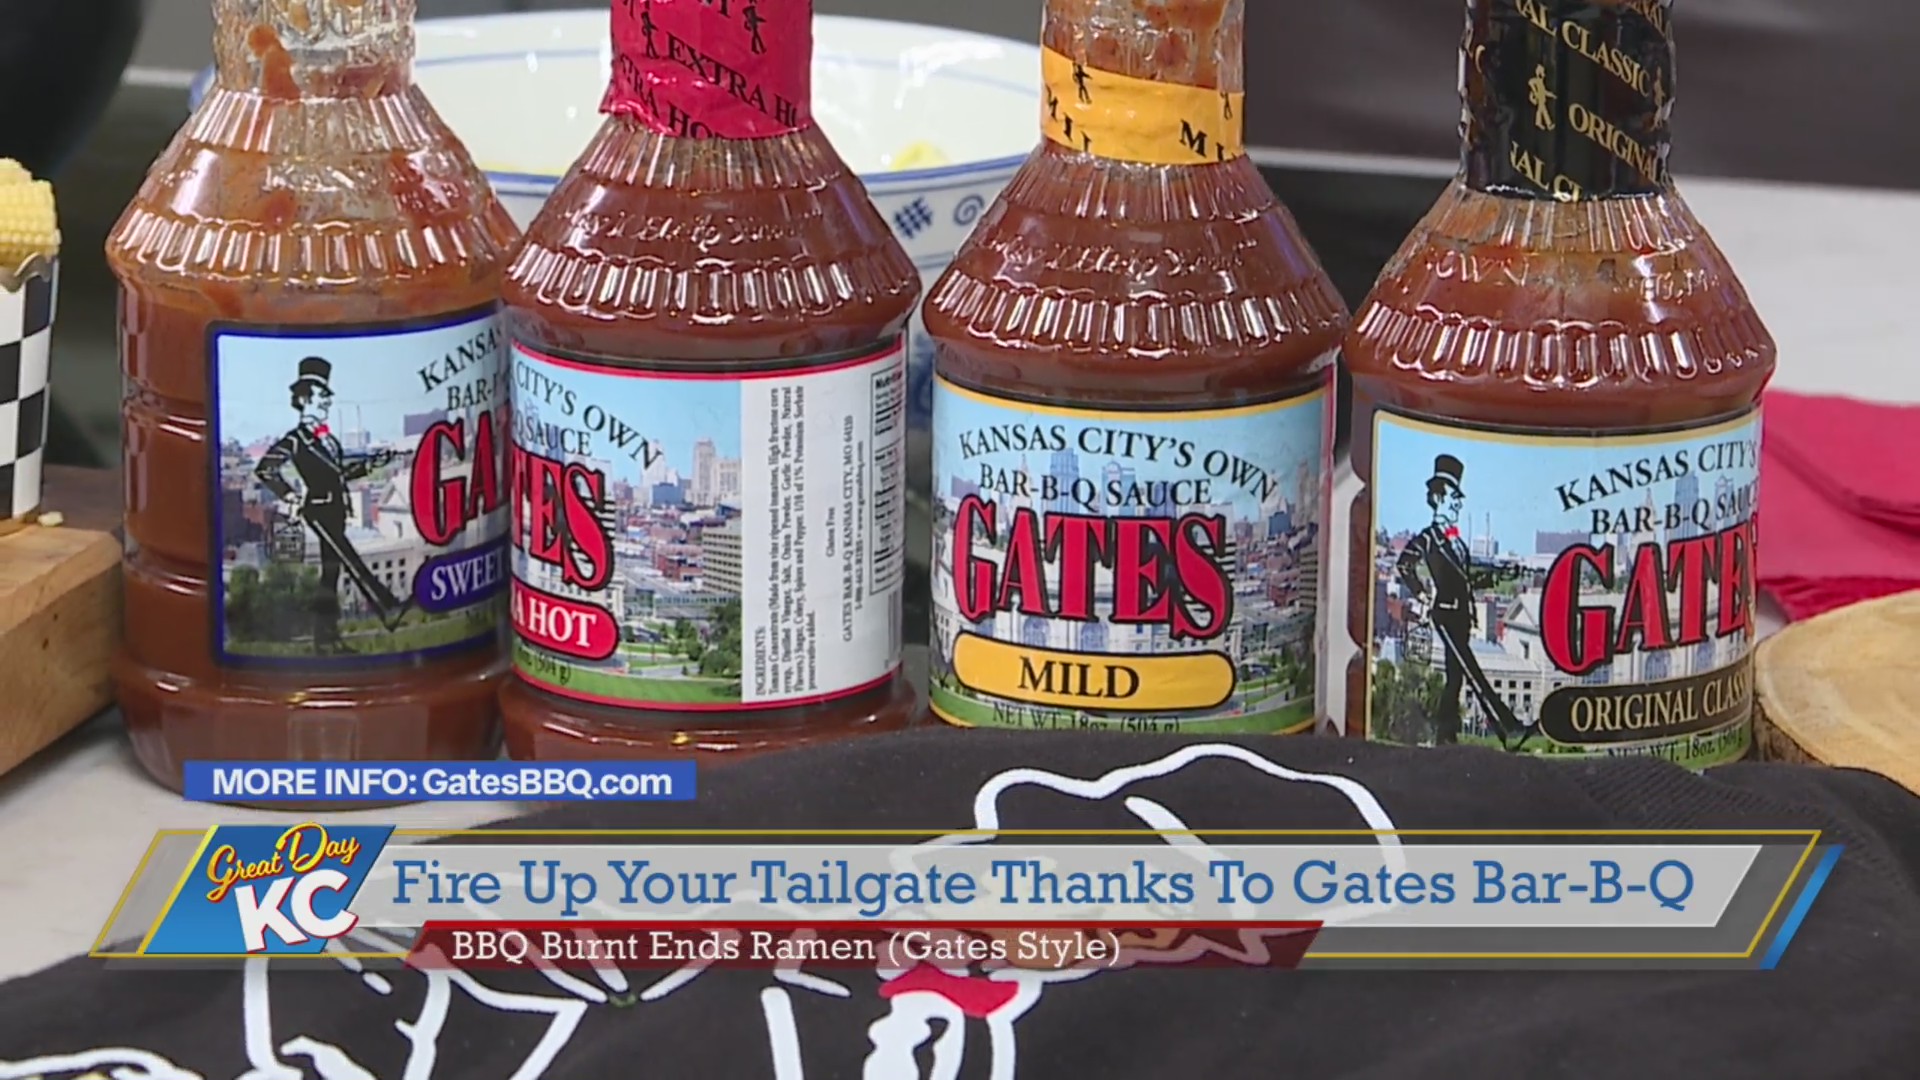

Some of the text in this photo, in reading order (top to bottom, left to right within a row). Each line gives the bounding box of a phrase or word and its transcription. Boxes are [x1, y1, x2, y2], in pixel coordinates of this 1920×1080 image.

[666, 31, 768, 114] EXTRA
[1562, 20, 1650, 97] CLASSIC
[516, 360, 664, 471] CITY'S OWN
[769, 387, 779, 408] corn
[781, 386, 792, 420] Natural
[793, 385, 804, 419] Sorbate
[526, 415, 592, 457] SAUCE
[767, 408, 779, 443] fructose
[793, 421, 804, 464] Potassium
[767, 444, 781, 466] High
[793, 465, 804, 481] 1%
[843, 445, 853, 465] MO
[958, 424, 1278, 504] KANSAS CITY'S OWN
[781, 463, 792, 491] Garlic
[843, 465, 854, 500] CITY,
[979, 462, 1212, 514] BAR-B-Q SAUCE
[1554, 449, 1689, 512] KANSAS
[825, 507, 836, 558] Gluten Free
[843, 501, 853, 548] KANSAS
[1590, 497, 1711, 535] BAR-B-Q
[769, 541, 779, 560] vine
[781, 533, 792, 561] Onion
[794, 548, 804, 565] and
[768, 560, 779, 582] from
[843, 550, 854, 600] BAR-B-Q
[951, 493, 1235, 641] GATES
[768, 583, 781, 610] (Made
[528, 596, 597, 648] HOT
[768, 611, 779, 663] Concentrate
[843, 602, 853, 642] GATES
[755, 625, 766, 696] INGREDIENTS:
[781, 628, 792, 663] Distilled
[768, 663, 779, 695] Tomato
[1018, 656, 1140, 700] MILD
[993, 701, 1027, 727] NET
[1571, 687, 1699, 733] ORIGINAL
